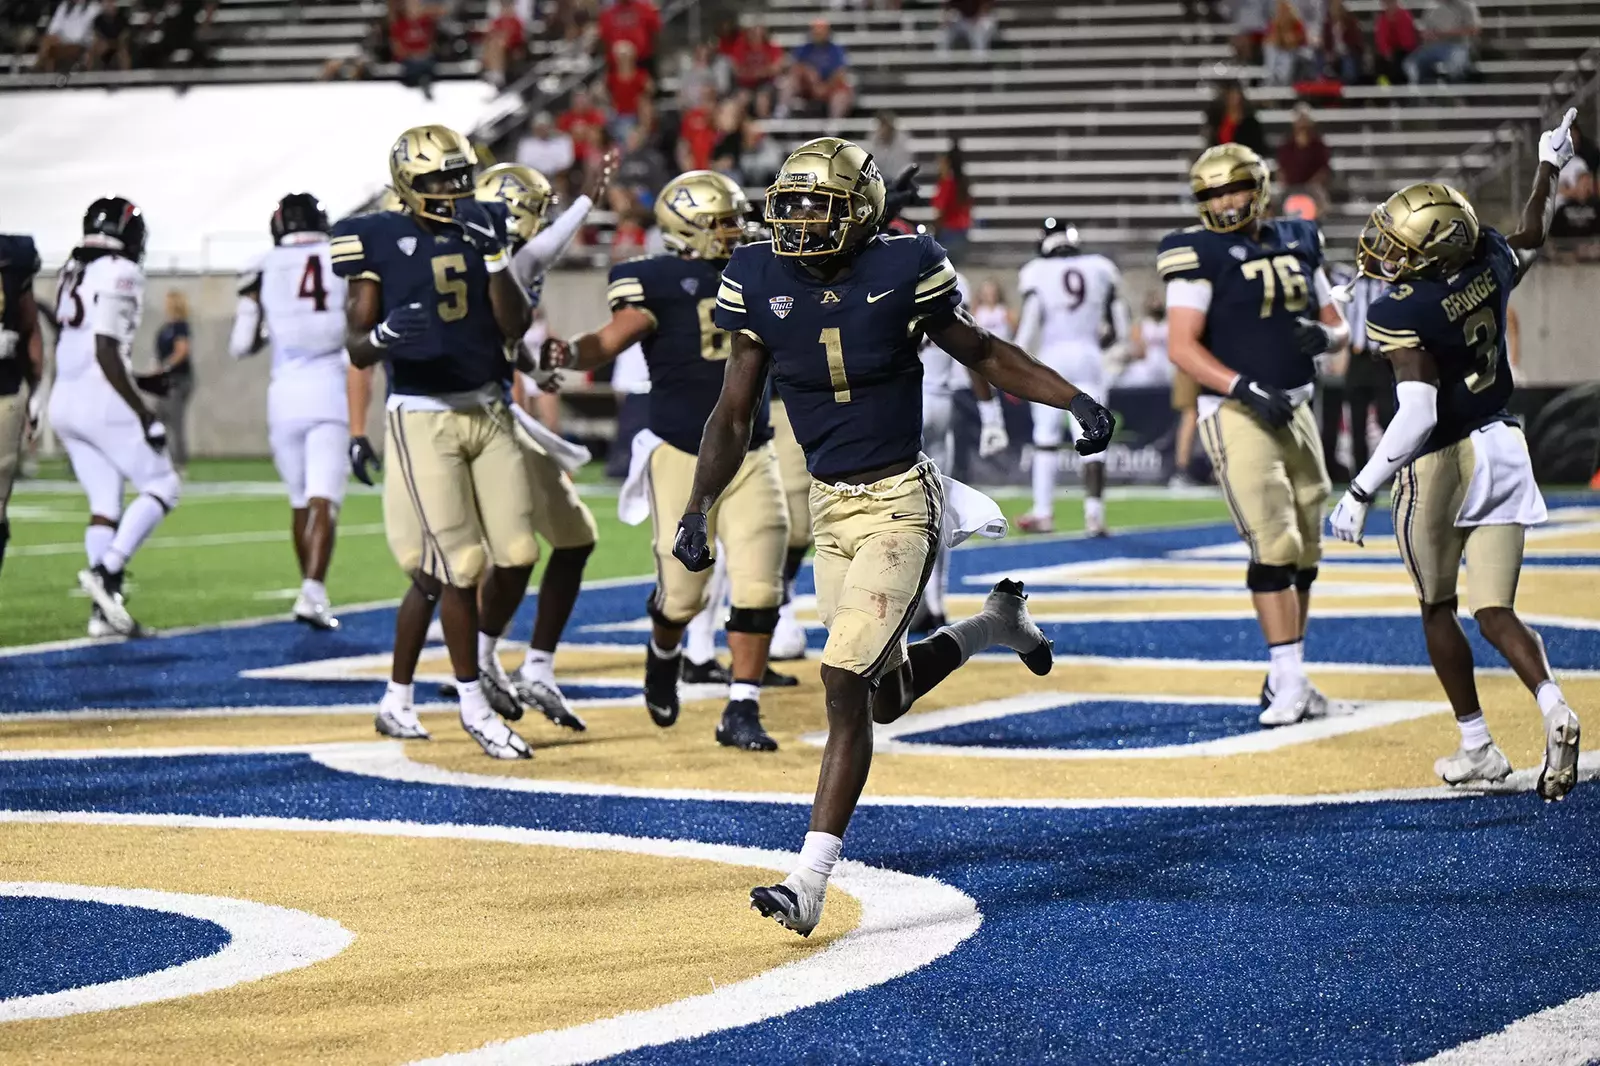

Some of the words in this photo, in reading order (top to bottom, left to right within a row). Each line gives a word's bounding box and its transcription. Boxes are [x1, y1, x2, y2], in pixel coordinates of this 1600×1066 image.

[671, 187, 698, 211] A
[1442, 219, 1471, 246] A
[298, 254, 328, 311] 4
[431, 254, 467, 322] 5
[820, 290, 841, 304] A
[1064, 269, 1085, 311] 9
[1241, 255, 1308, 319] 76
[1389, 283, 1414, 300] 3
[1441, 268, 1497, 322] GEORGE
[818, 327, 851, 403] 1
[1463, 306, 1498, 394] 3
